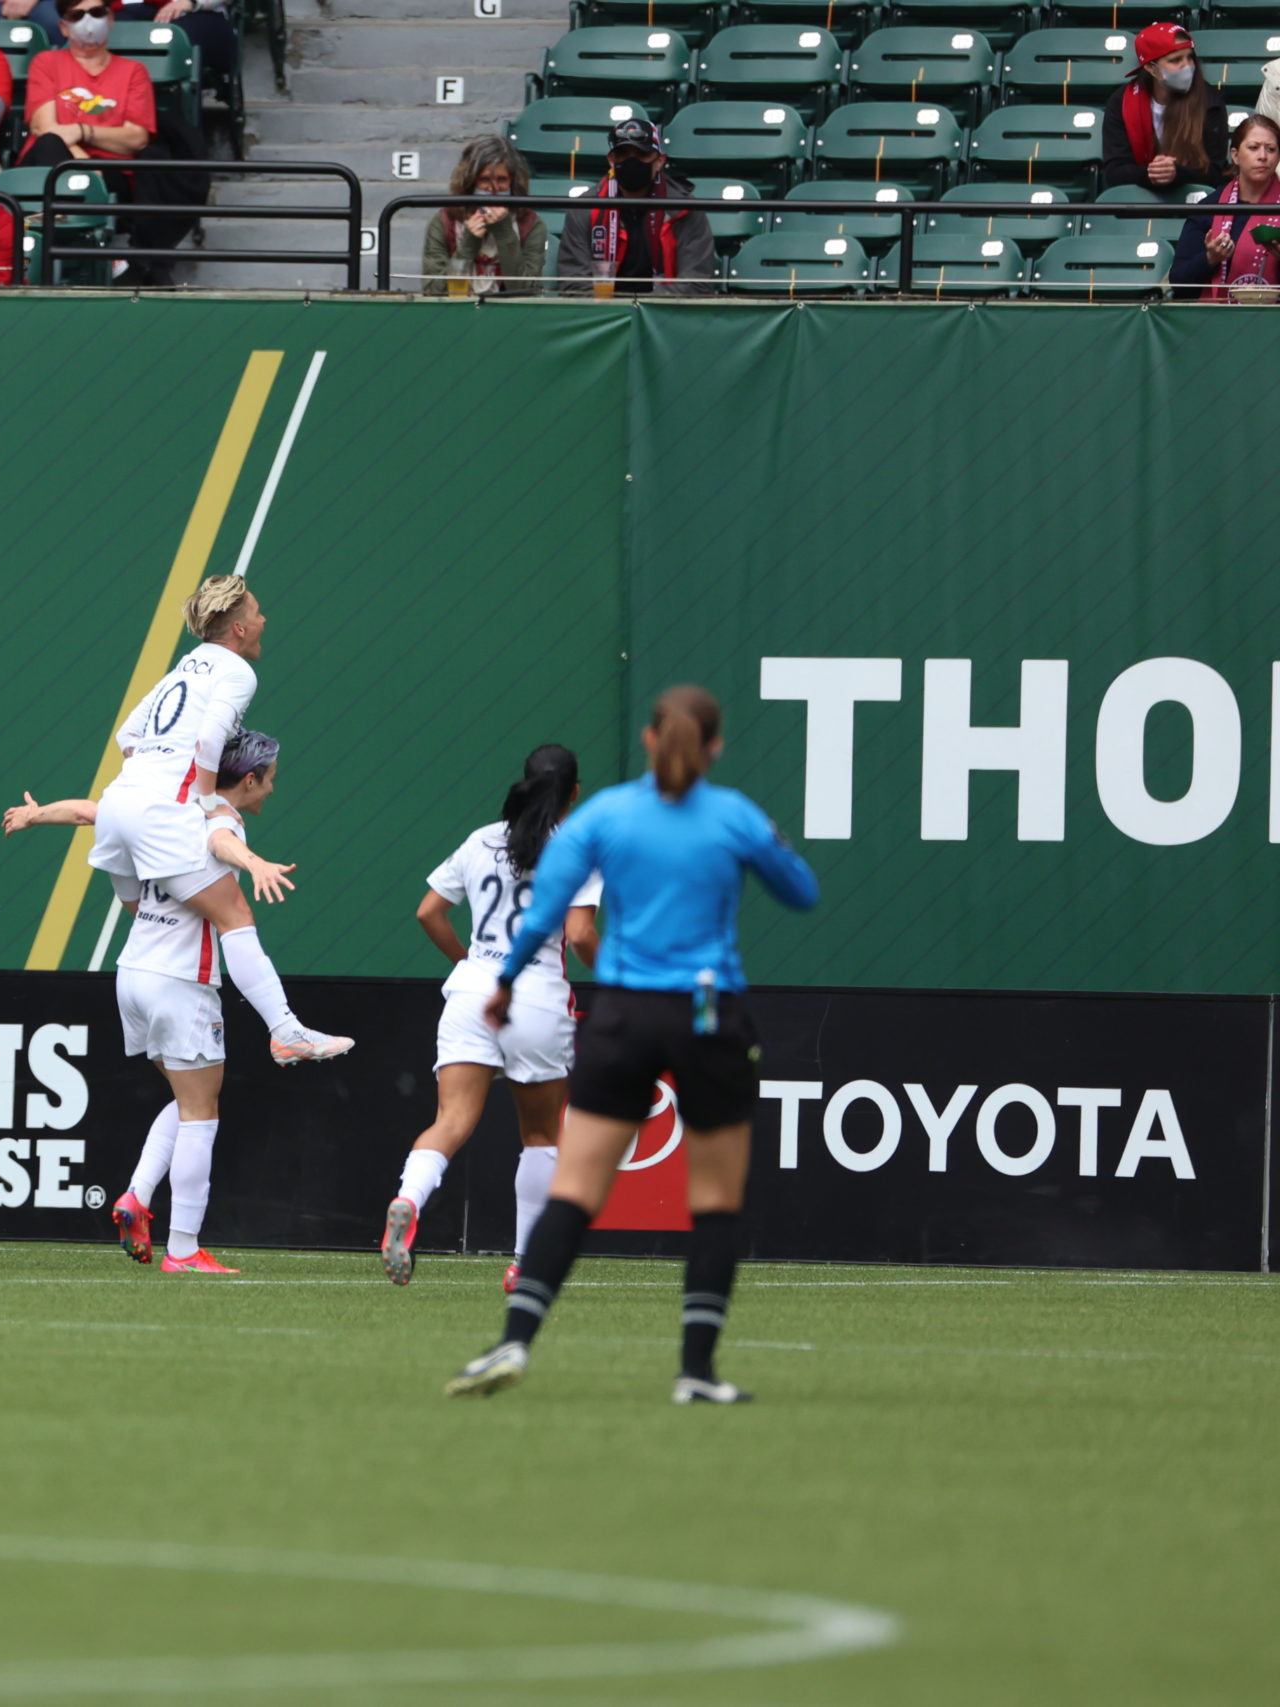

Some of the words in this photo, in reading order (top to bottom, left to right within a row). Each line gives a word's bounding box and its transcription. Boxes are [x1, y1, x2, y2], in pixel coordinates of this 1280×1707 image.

[443, 79, 457, 101] F
[398, 154, 413, 176] E
[361, 230, 376, 251] D
[760, 656, 1280, 846] THO
[138, 911, 179, 926] BOEING
[759, 1079, 1197, 1180] TOYOTA
